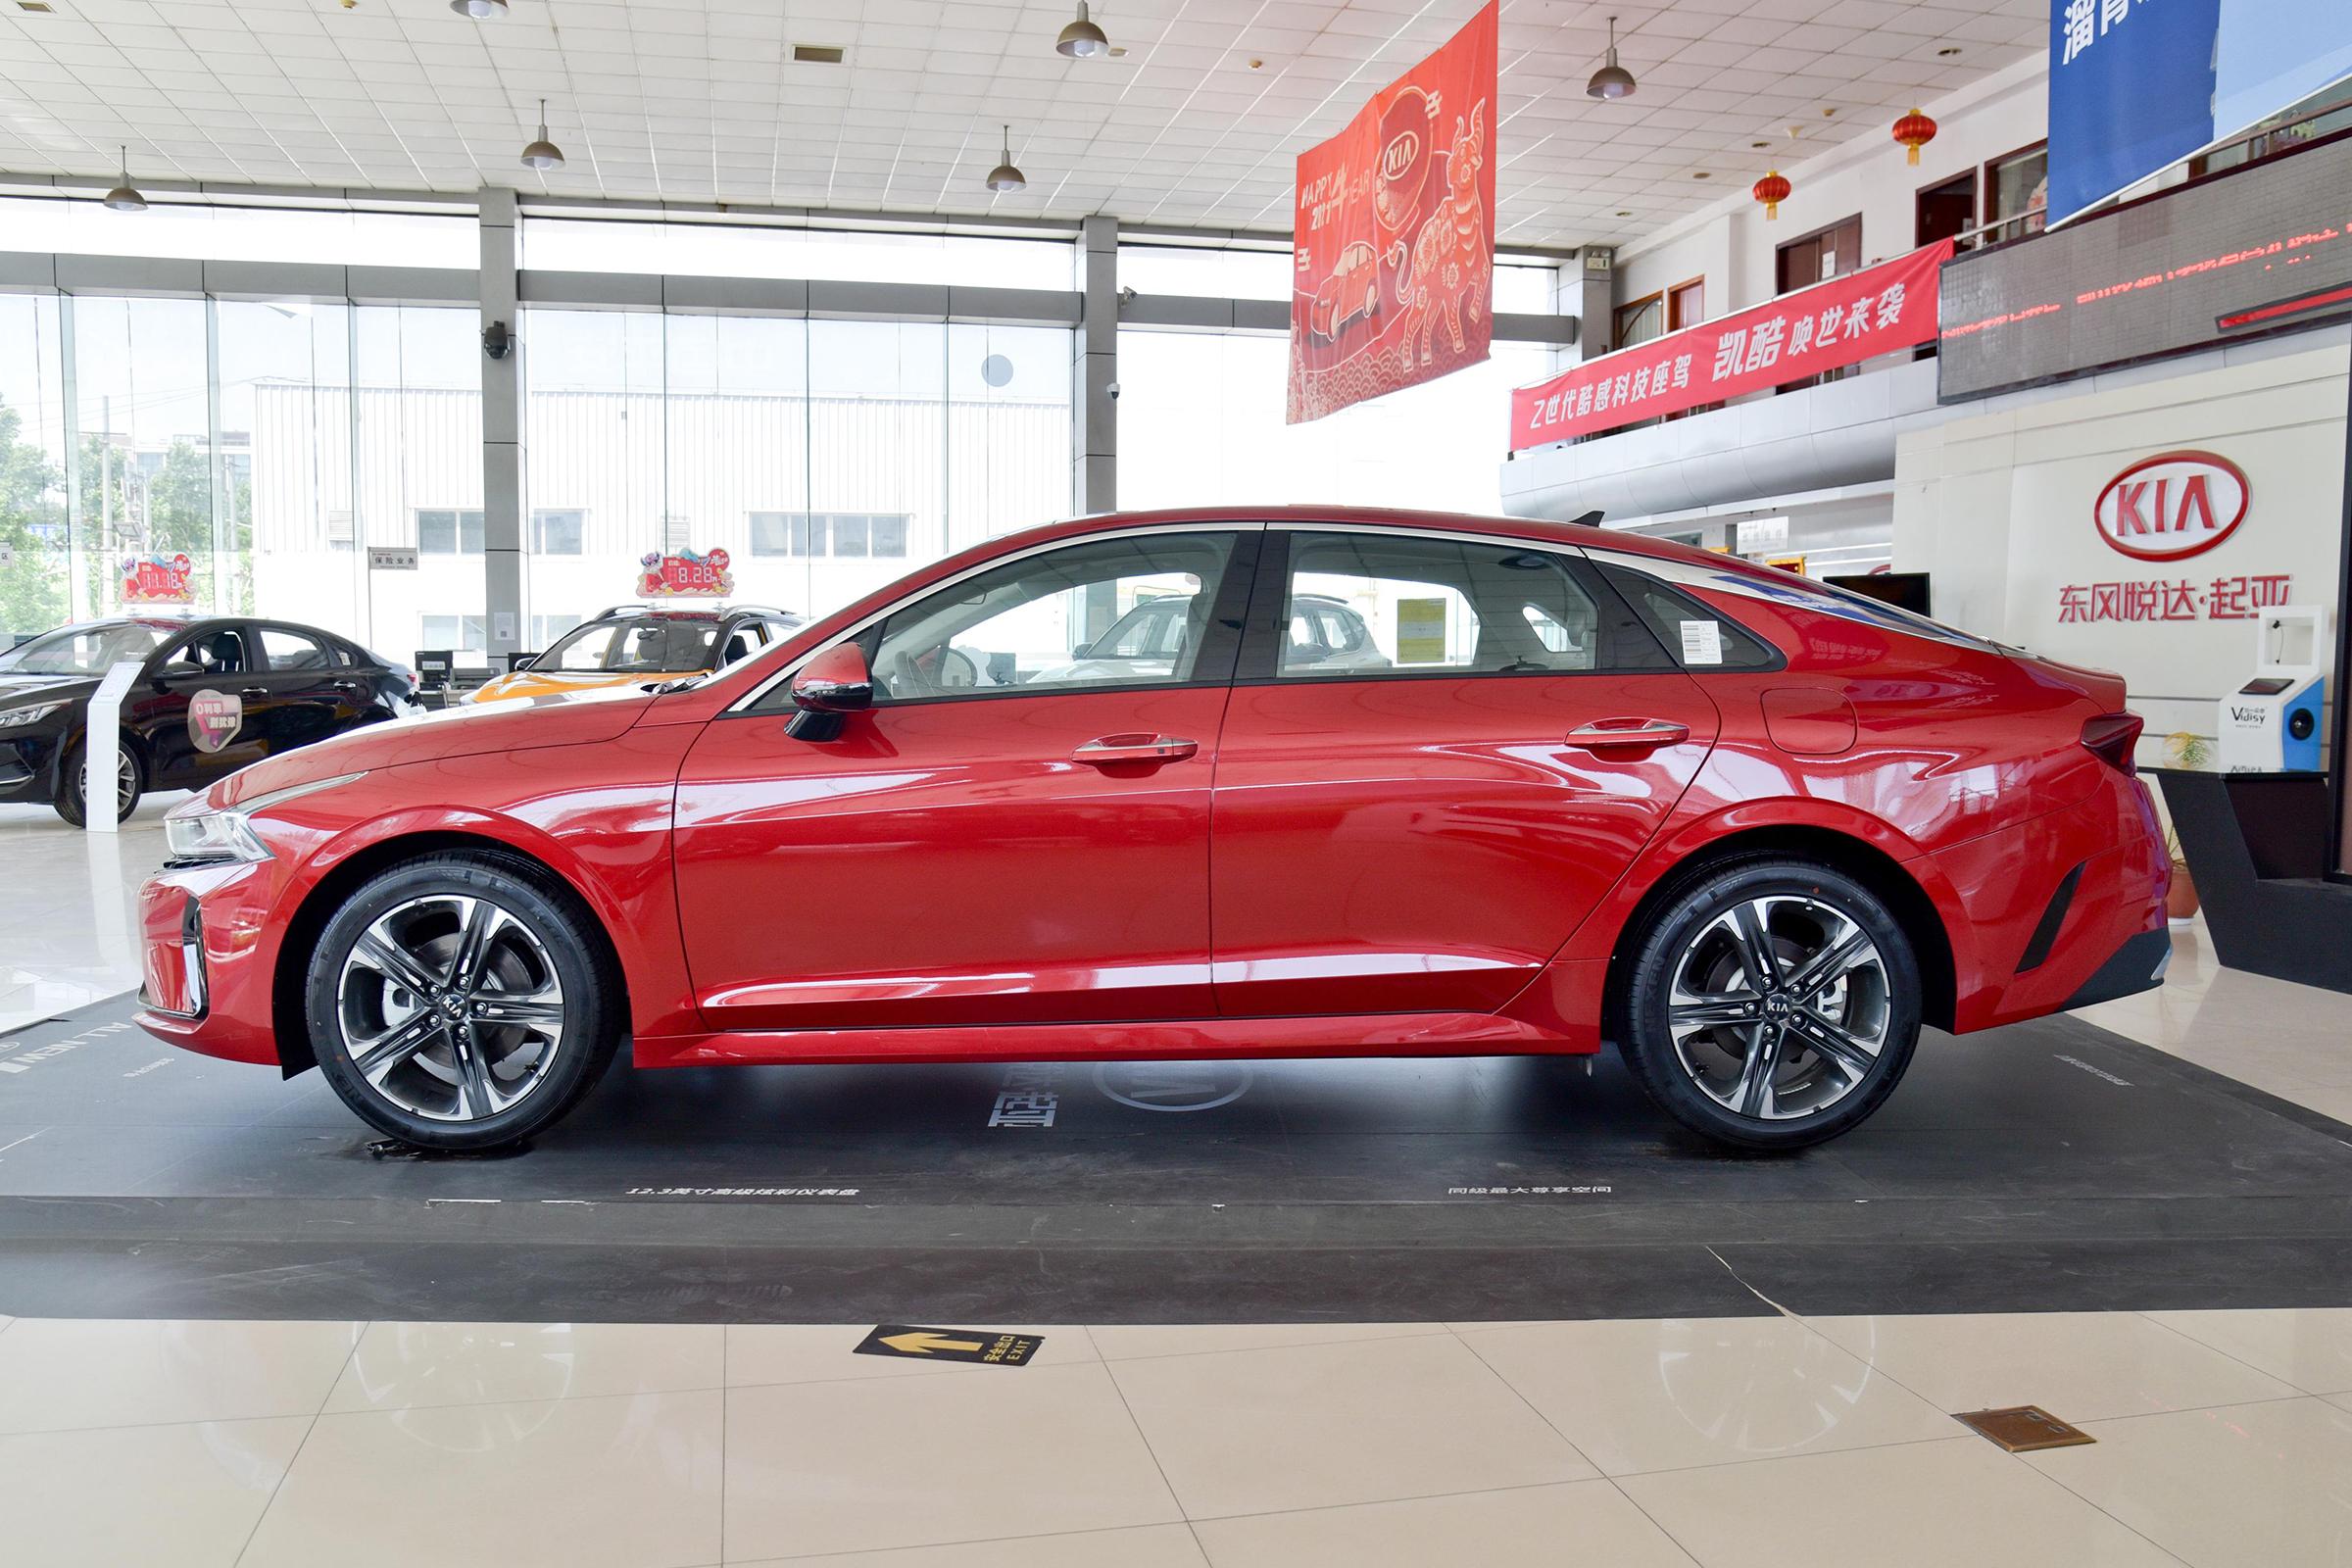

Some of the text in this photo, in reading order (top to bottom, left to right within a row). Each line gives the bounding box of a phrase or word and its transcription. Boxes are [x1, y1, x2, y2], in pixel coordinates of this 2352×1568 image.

[1388, 139, 1411, 173] KIA
[1300, 172, 1333, 209] HAPPY
[1530, 354, 1692, 429] Z世代酷感科技座驾
[1712, 315, 1787, 382] 凯酷
[2116, 475, 2218, 537] KIA
[374, 556, 416, 564] 保险业务
[678, 567, 712, 584] 8.28
[2230, 707, 2266, 724] Vidisy
[442, 997, 463, 1017] KIA
[1767, 1002, 1788, 1012] KIA
[12, 1021, 133, 1064] ALL NEW
[983, 1335, 1016, 1362] 安全出口
[1005, 1340, 1031, 1361] EXIT
